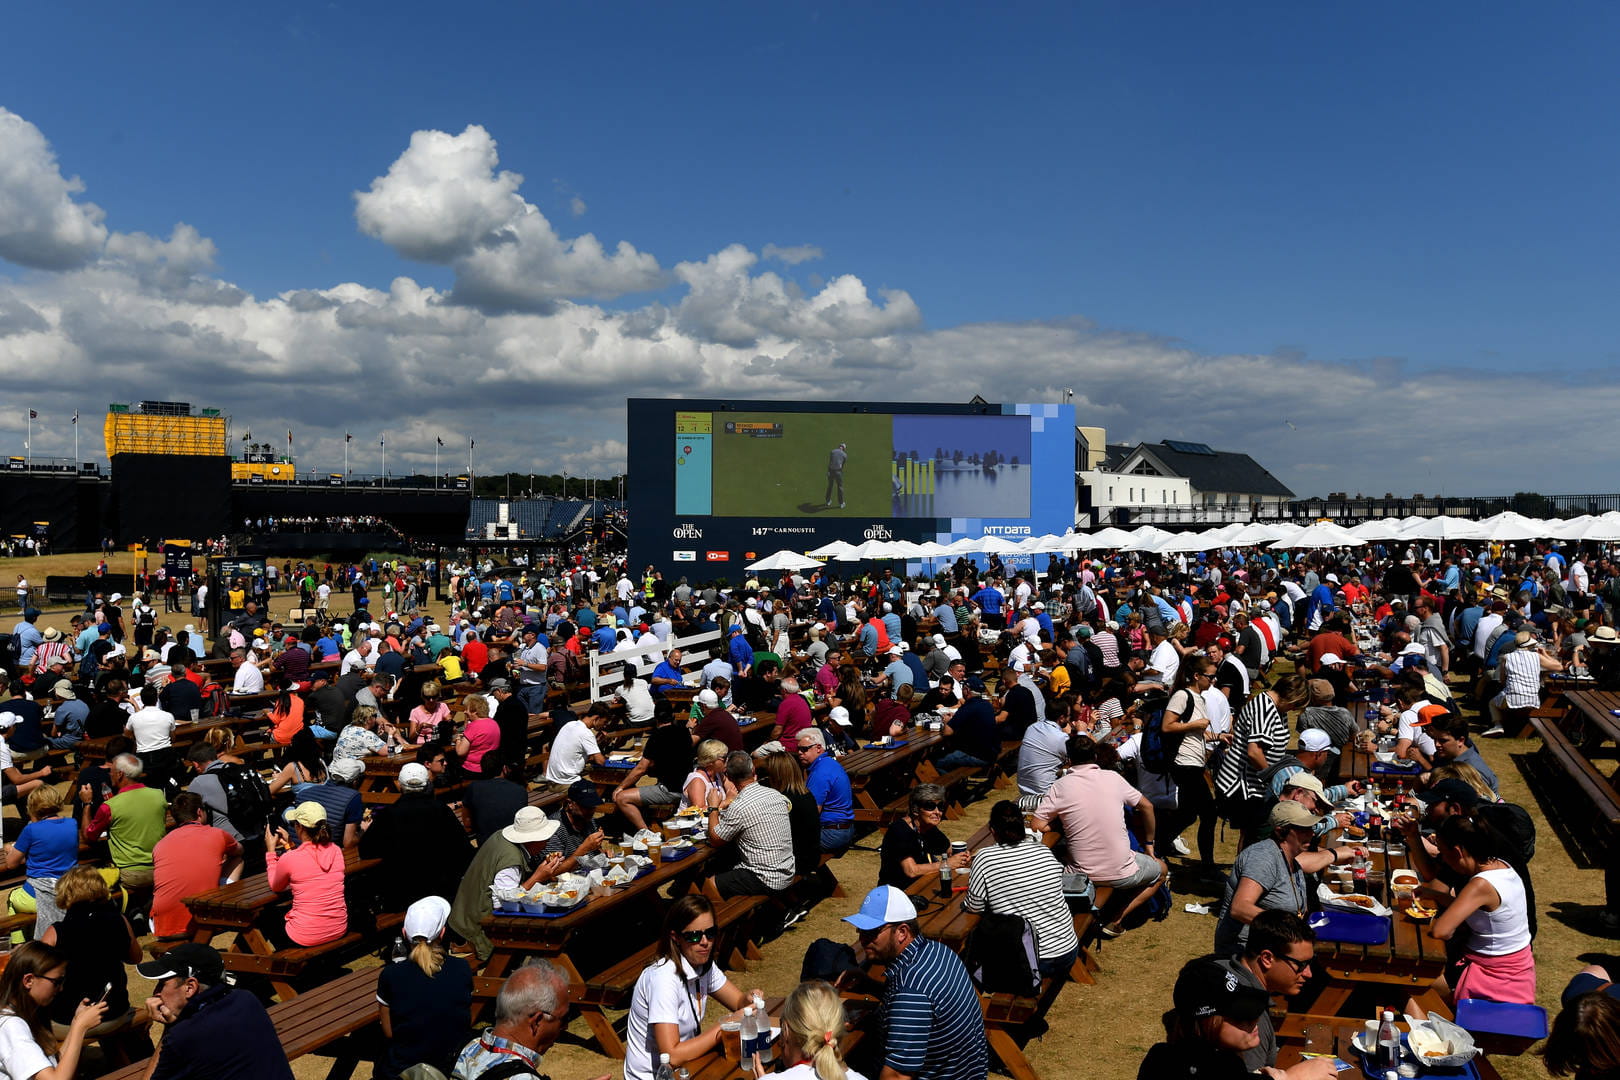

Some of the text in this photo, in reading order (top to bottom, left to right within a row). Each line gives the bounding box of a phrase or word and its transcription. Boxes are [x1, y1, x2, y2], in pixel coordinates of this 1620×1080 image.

[673, 528, 703, 539] OPEN
[863, 528, 892, 539] OPEN
[983, 526, 1003, 534] NTT
